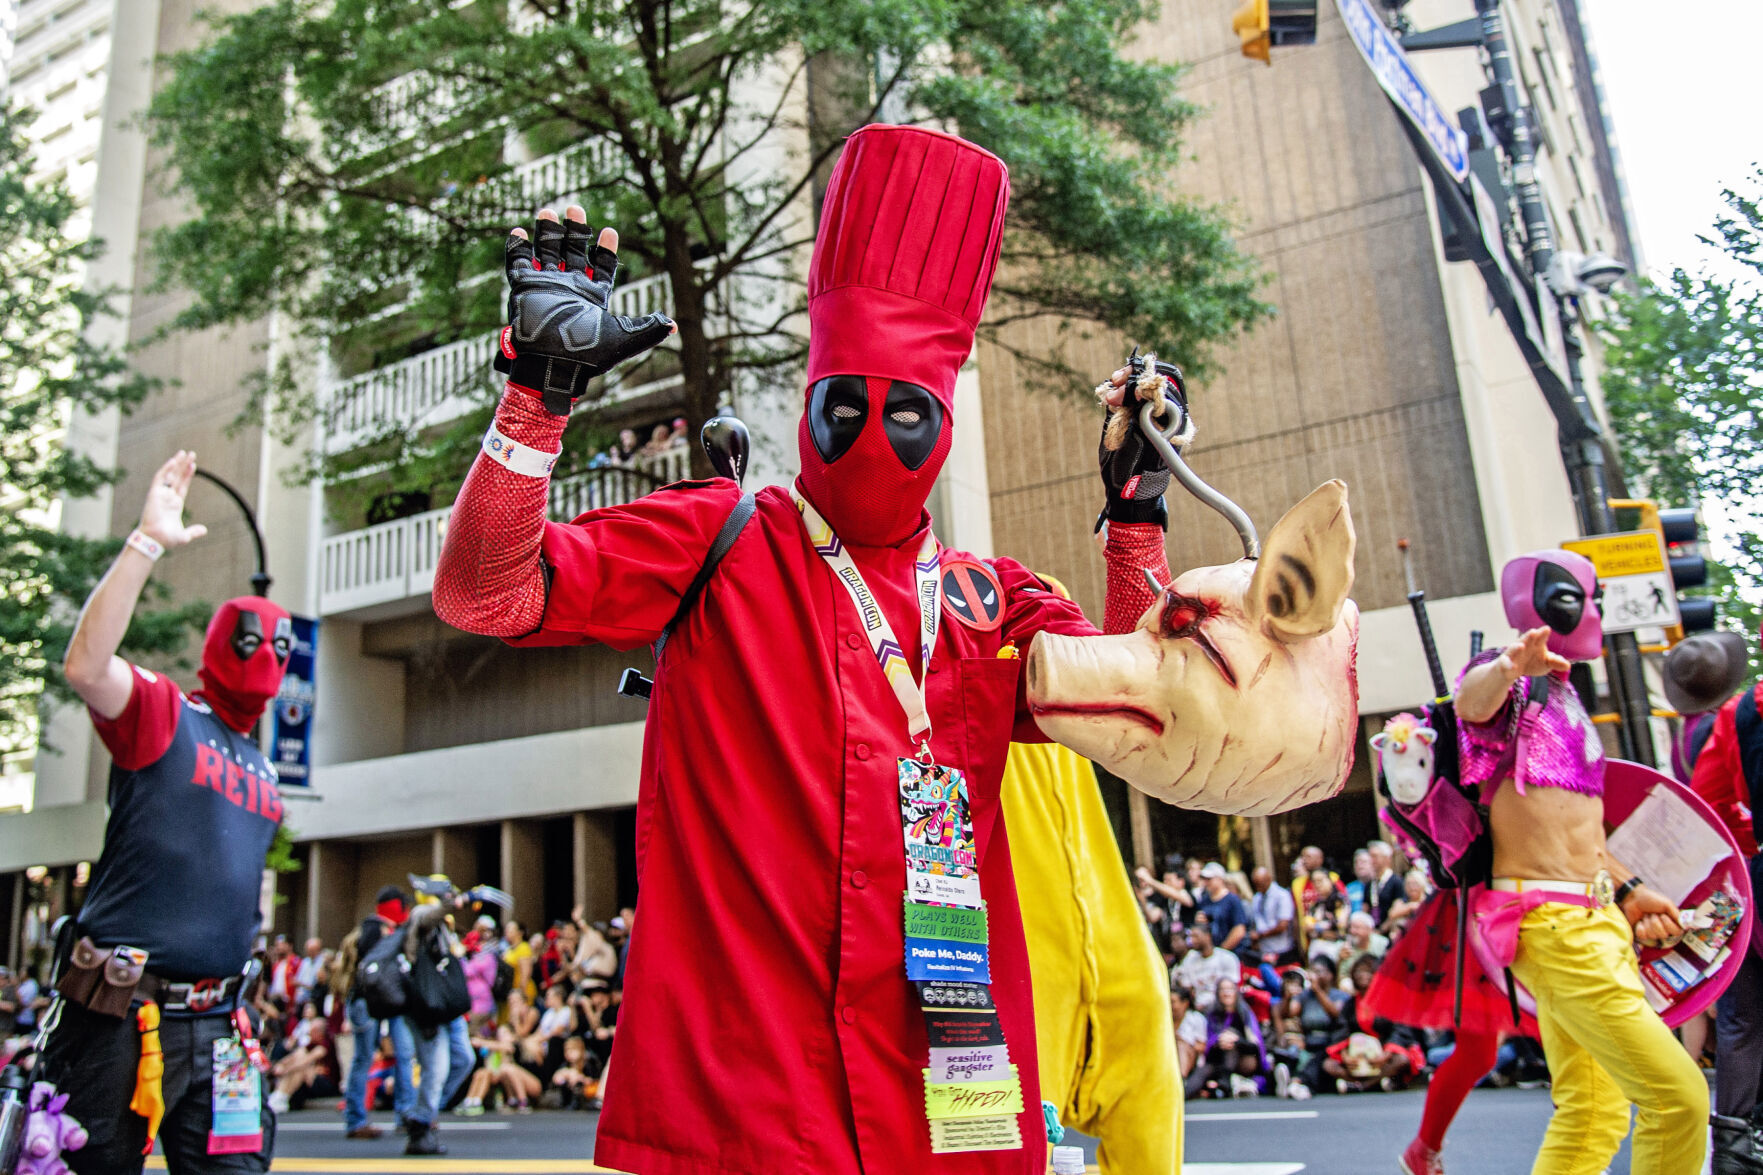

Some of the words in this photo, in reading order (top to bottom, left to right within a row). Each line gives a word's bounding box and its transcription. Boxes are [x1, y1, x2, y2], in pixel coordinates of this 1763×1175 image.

[1601, 556, 1660, 571] VEHICLES
[922, 580, 937, 597] CON
[839, 567, 874, 607] DRAGON
[863, 604, 882, 631] CON
[910, 844, 953, 864] DRAGON
[912, 910, 947, 923] PLAYS
[950, 913, 977, 926] WELL
[910, 922, 936, 935] WITH
[941, 926, 980, 939] OTHERS
[911, 947, 937, 958] Poke
[938, 948, 955, 960] Me,
[955, 950, 984, 963] Daddy.
[946, 1051, 993, 1063] sensitive
[946, 1063, 994, 1079] gangster
